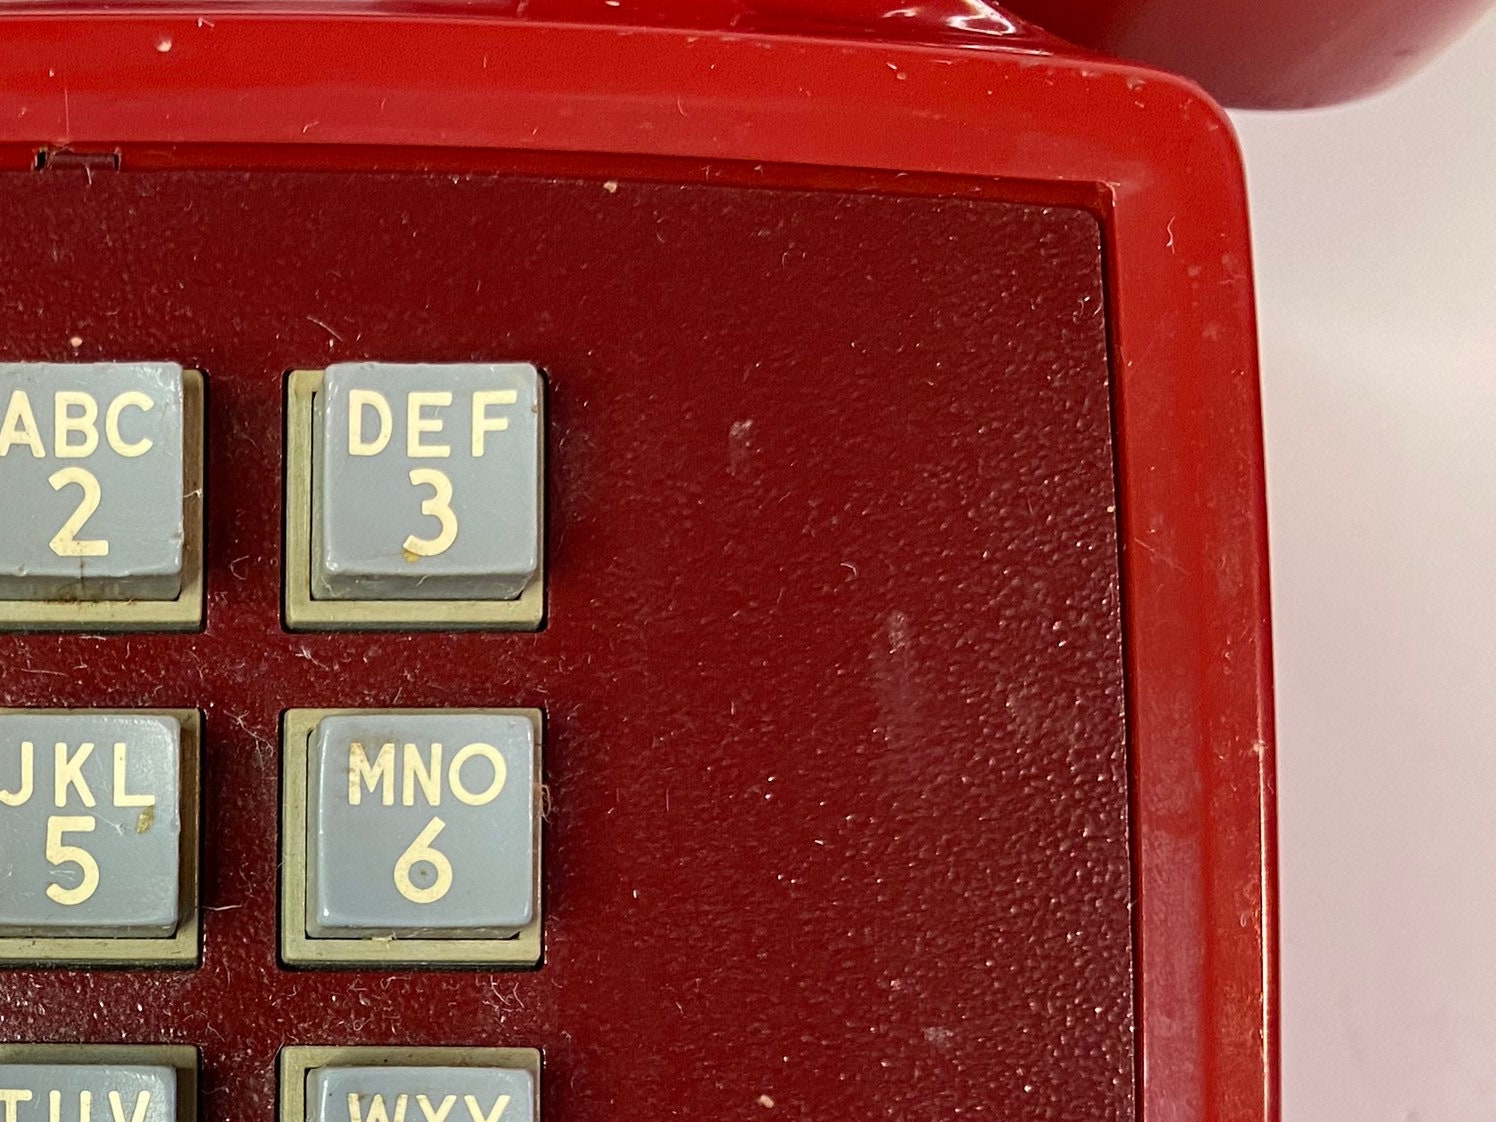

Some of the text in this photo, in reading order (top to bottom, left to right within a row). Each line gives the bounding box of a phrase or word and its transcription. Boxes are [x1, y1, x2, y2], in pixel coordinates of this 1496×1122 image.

[347, 388, 522, 459] DEF
[48, 466, 109, 556] 2
[402, 466, 459, 557] 3
[349, 740, 508, 807] MNO
[46, 815, 99, 905] 5
[394, 818, 453, 903] 6
